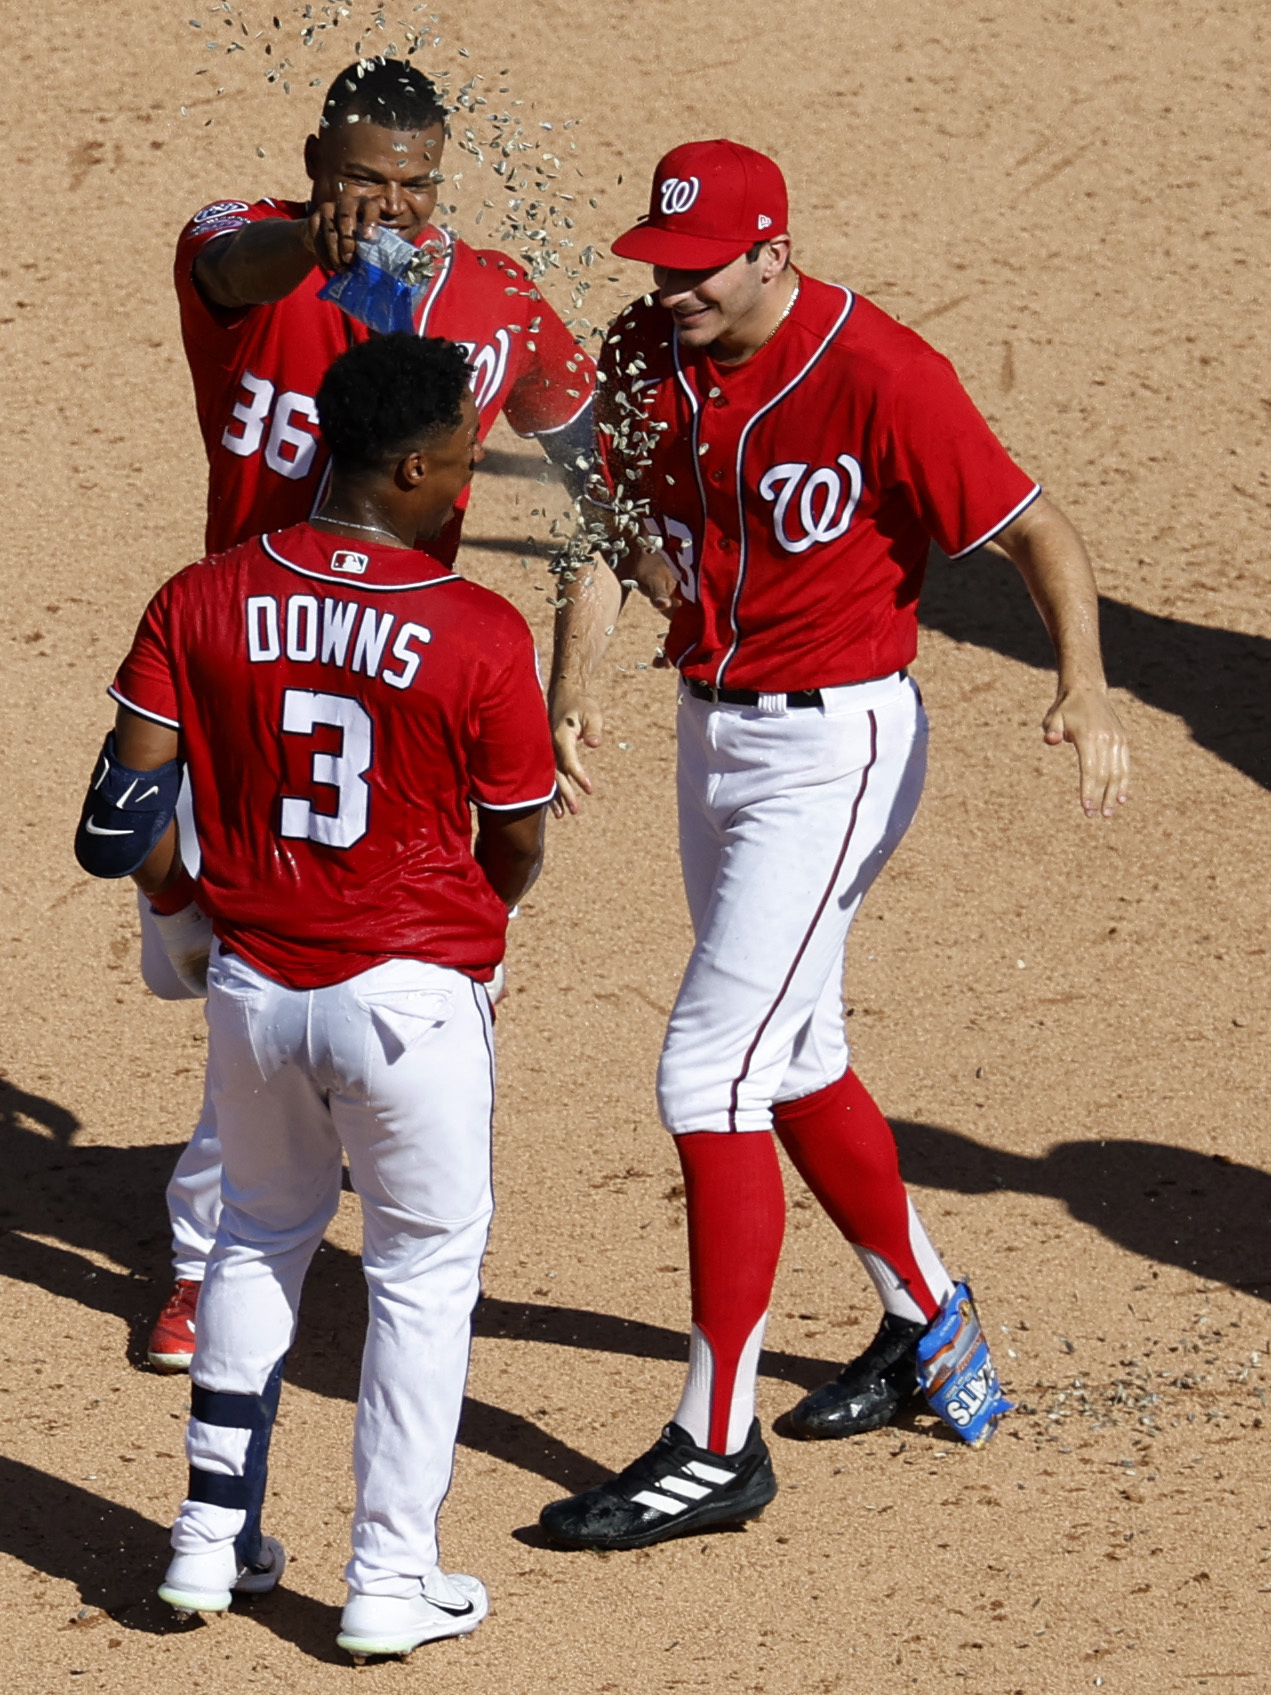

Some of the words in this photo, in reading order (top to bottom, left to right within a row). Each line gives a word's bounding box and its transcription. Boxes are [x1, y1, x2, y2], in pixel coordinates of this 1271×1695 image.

[659, 176, 701, 215] W
[221, 369, 320, 480] 36
[758, 452, 864, 554] W
[246, 594, 432, 690] DOWNS
[280, 687, 374, 849] 3
